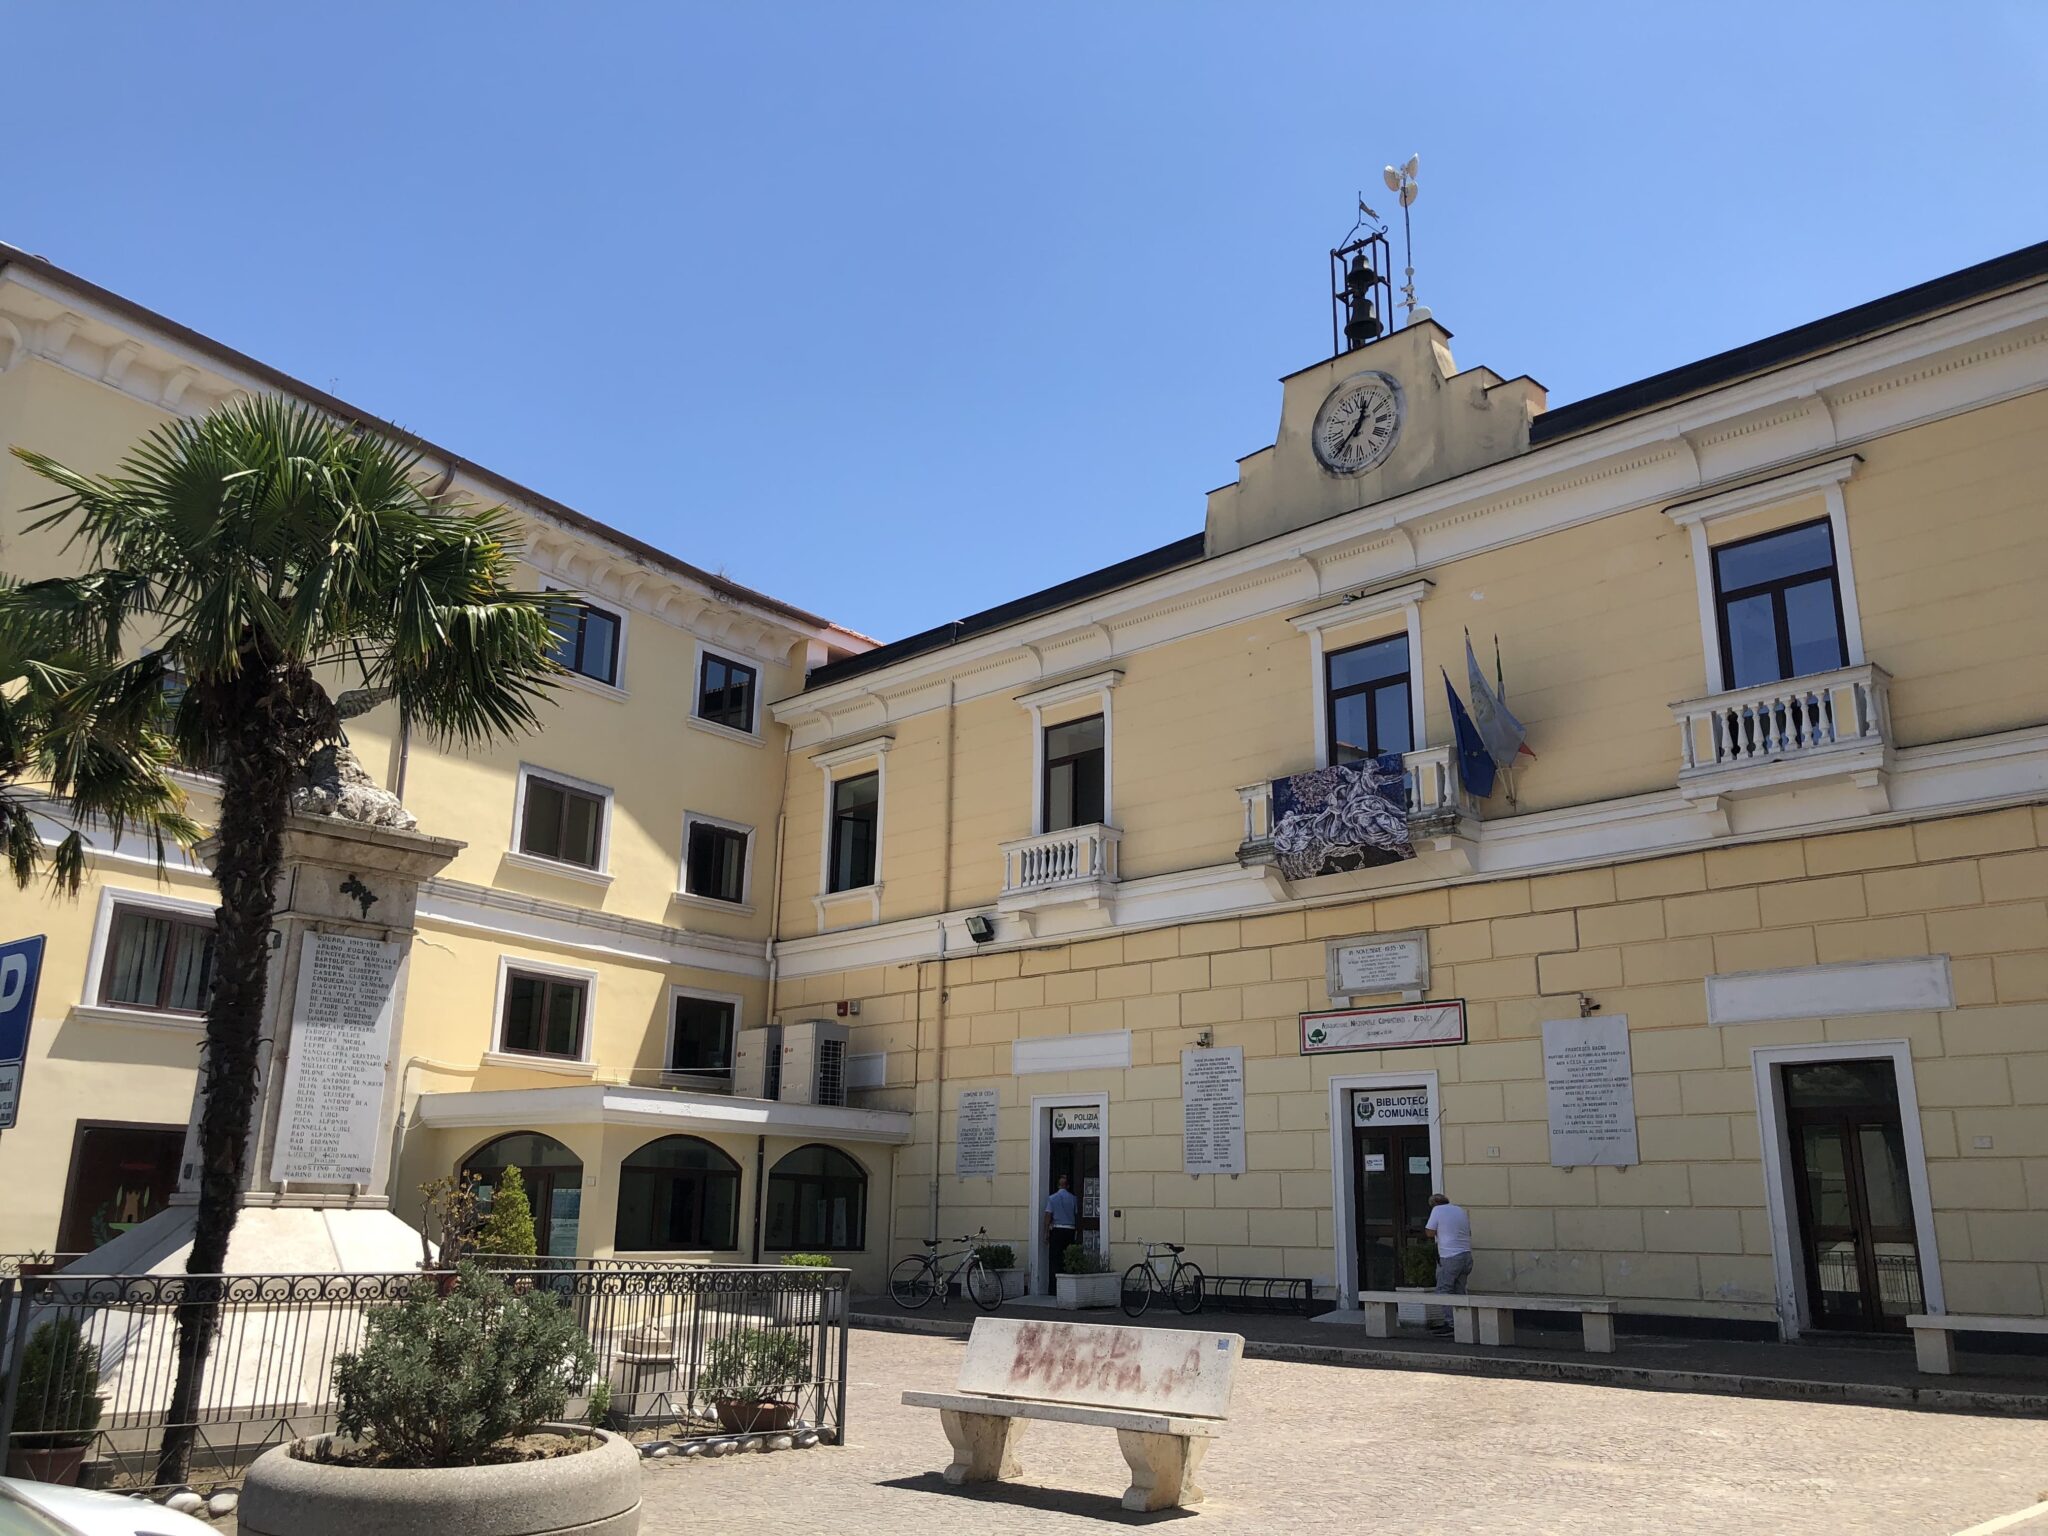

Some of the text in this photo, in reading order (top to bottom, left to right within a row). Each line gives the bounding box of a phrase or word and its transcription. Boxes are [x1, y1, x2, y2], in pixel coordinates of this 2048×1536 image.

[318, 935, 345, 944] GUERRA
[1074, 1113, 1098, 1121] POLIZIA
[1378, 1108, 1429, 1118] COMUNALE
[1068, 1122, 1100, 1130] MUNICIPAL
